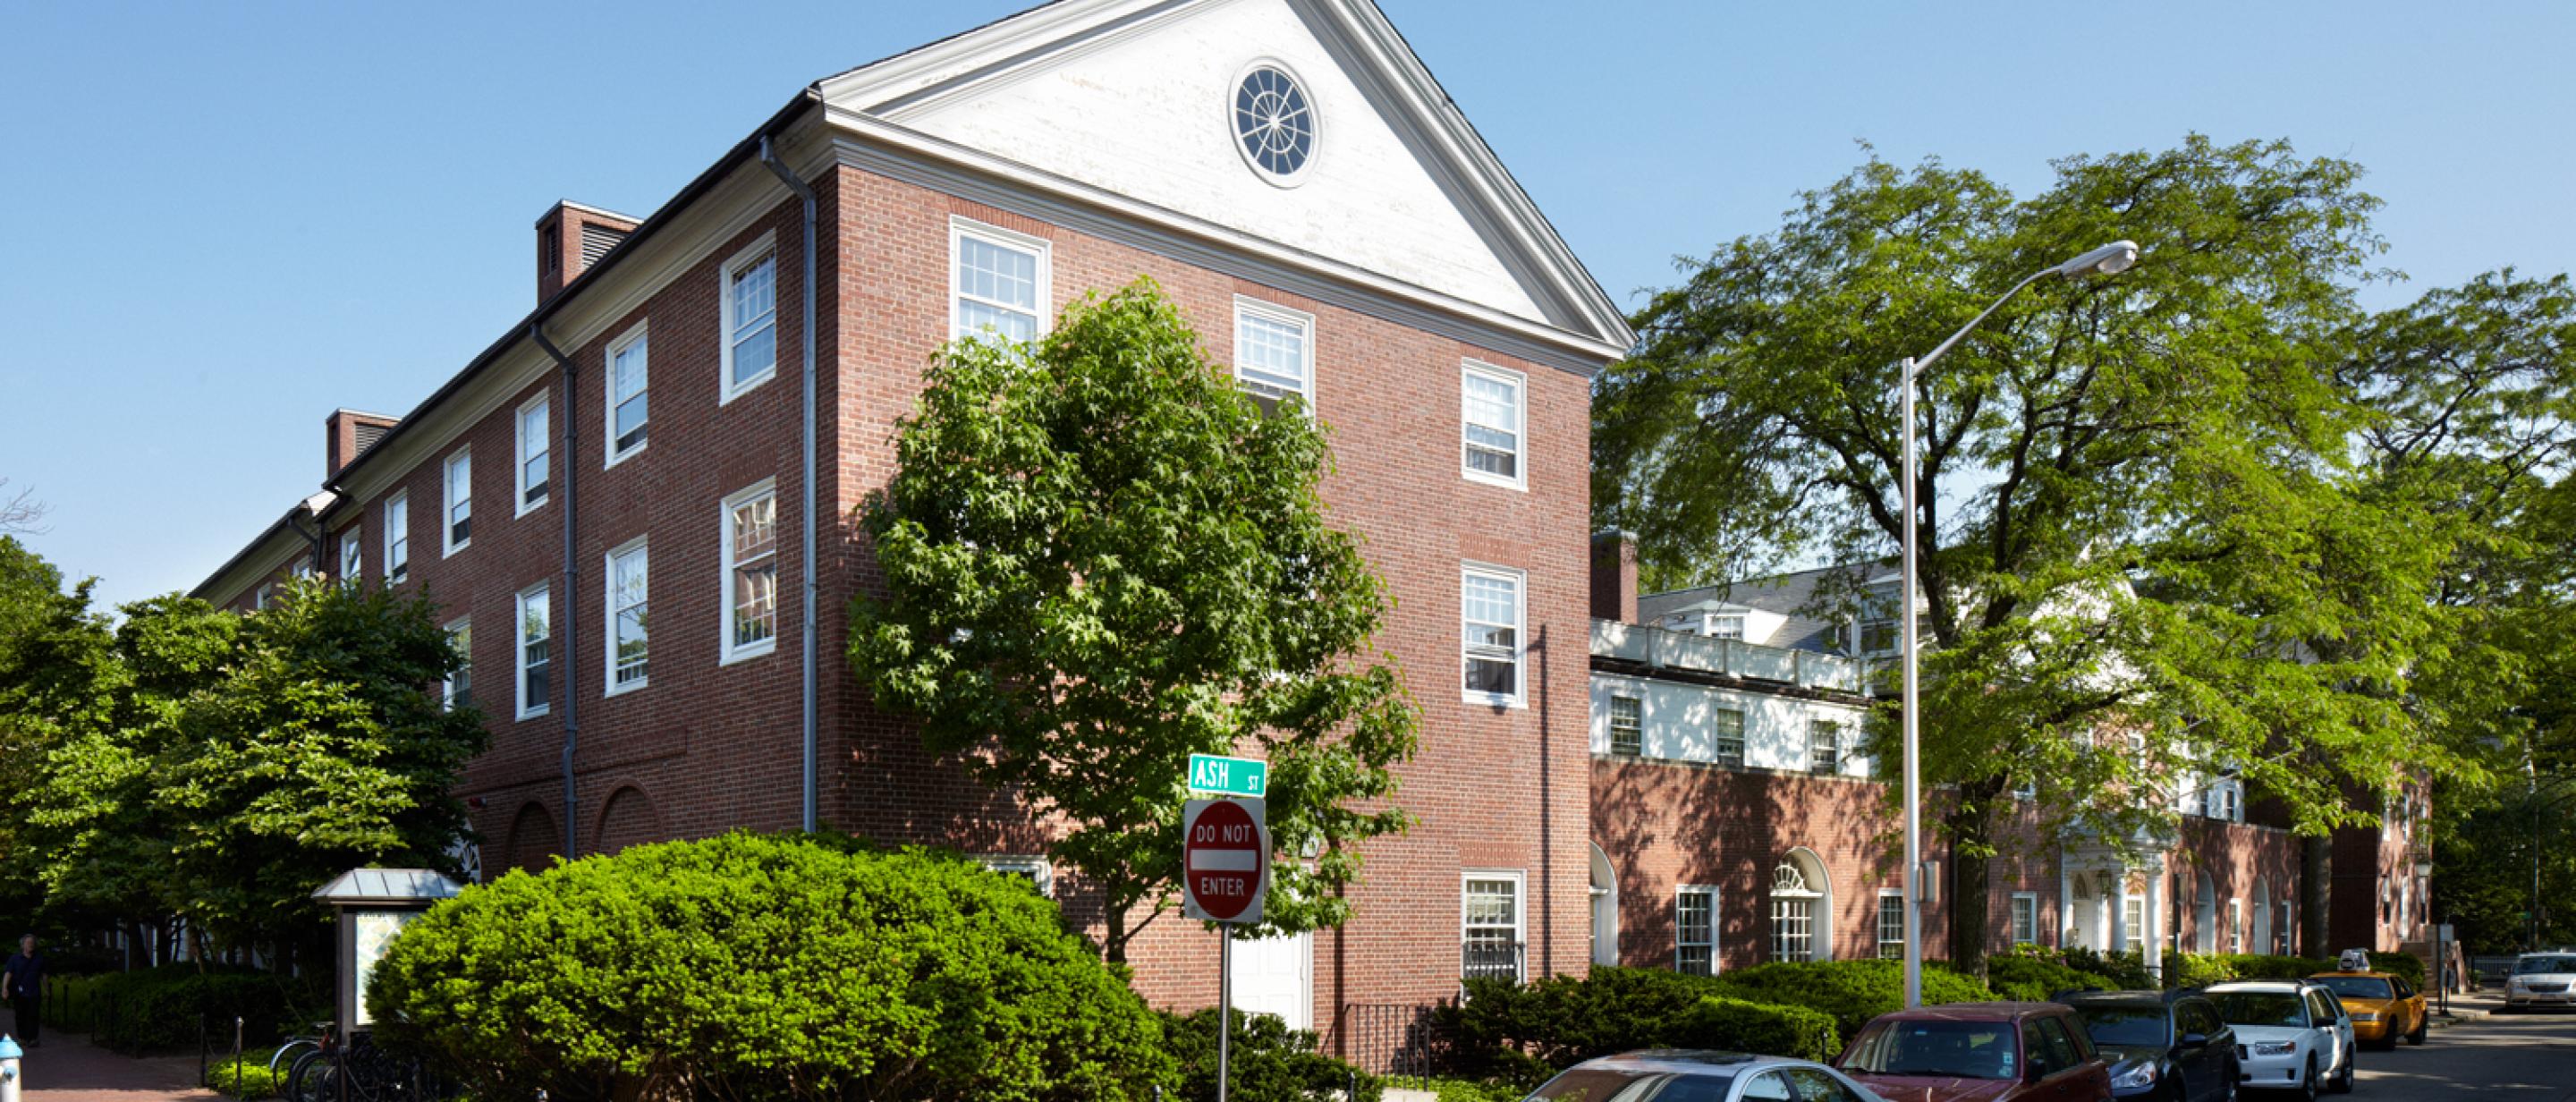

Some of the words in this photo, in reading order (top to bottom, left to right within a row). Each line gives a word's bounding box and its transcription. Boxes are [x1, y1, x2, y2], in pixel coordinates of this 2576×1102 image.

[1195, 760, 1229, 788] ASH
[1249, 776, 1259, 791] ST
[1197, 825, 1215, 843] DO
[1223, 825, 1250, 843] NOT
[1201, 877, 1244, 895] ENTER
